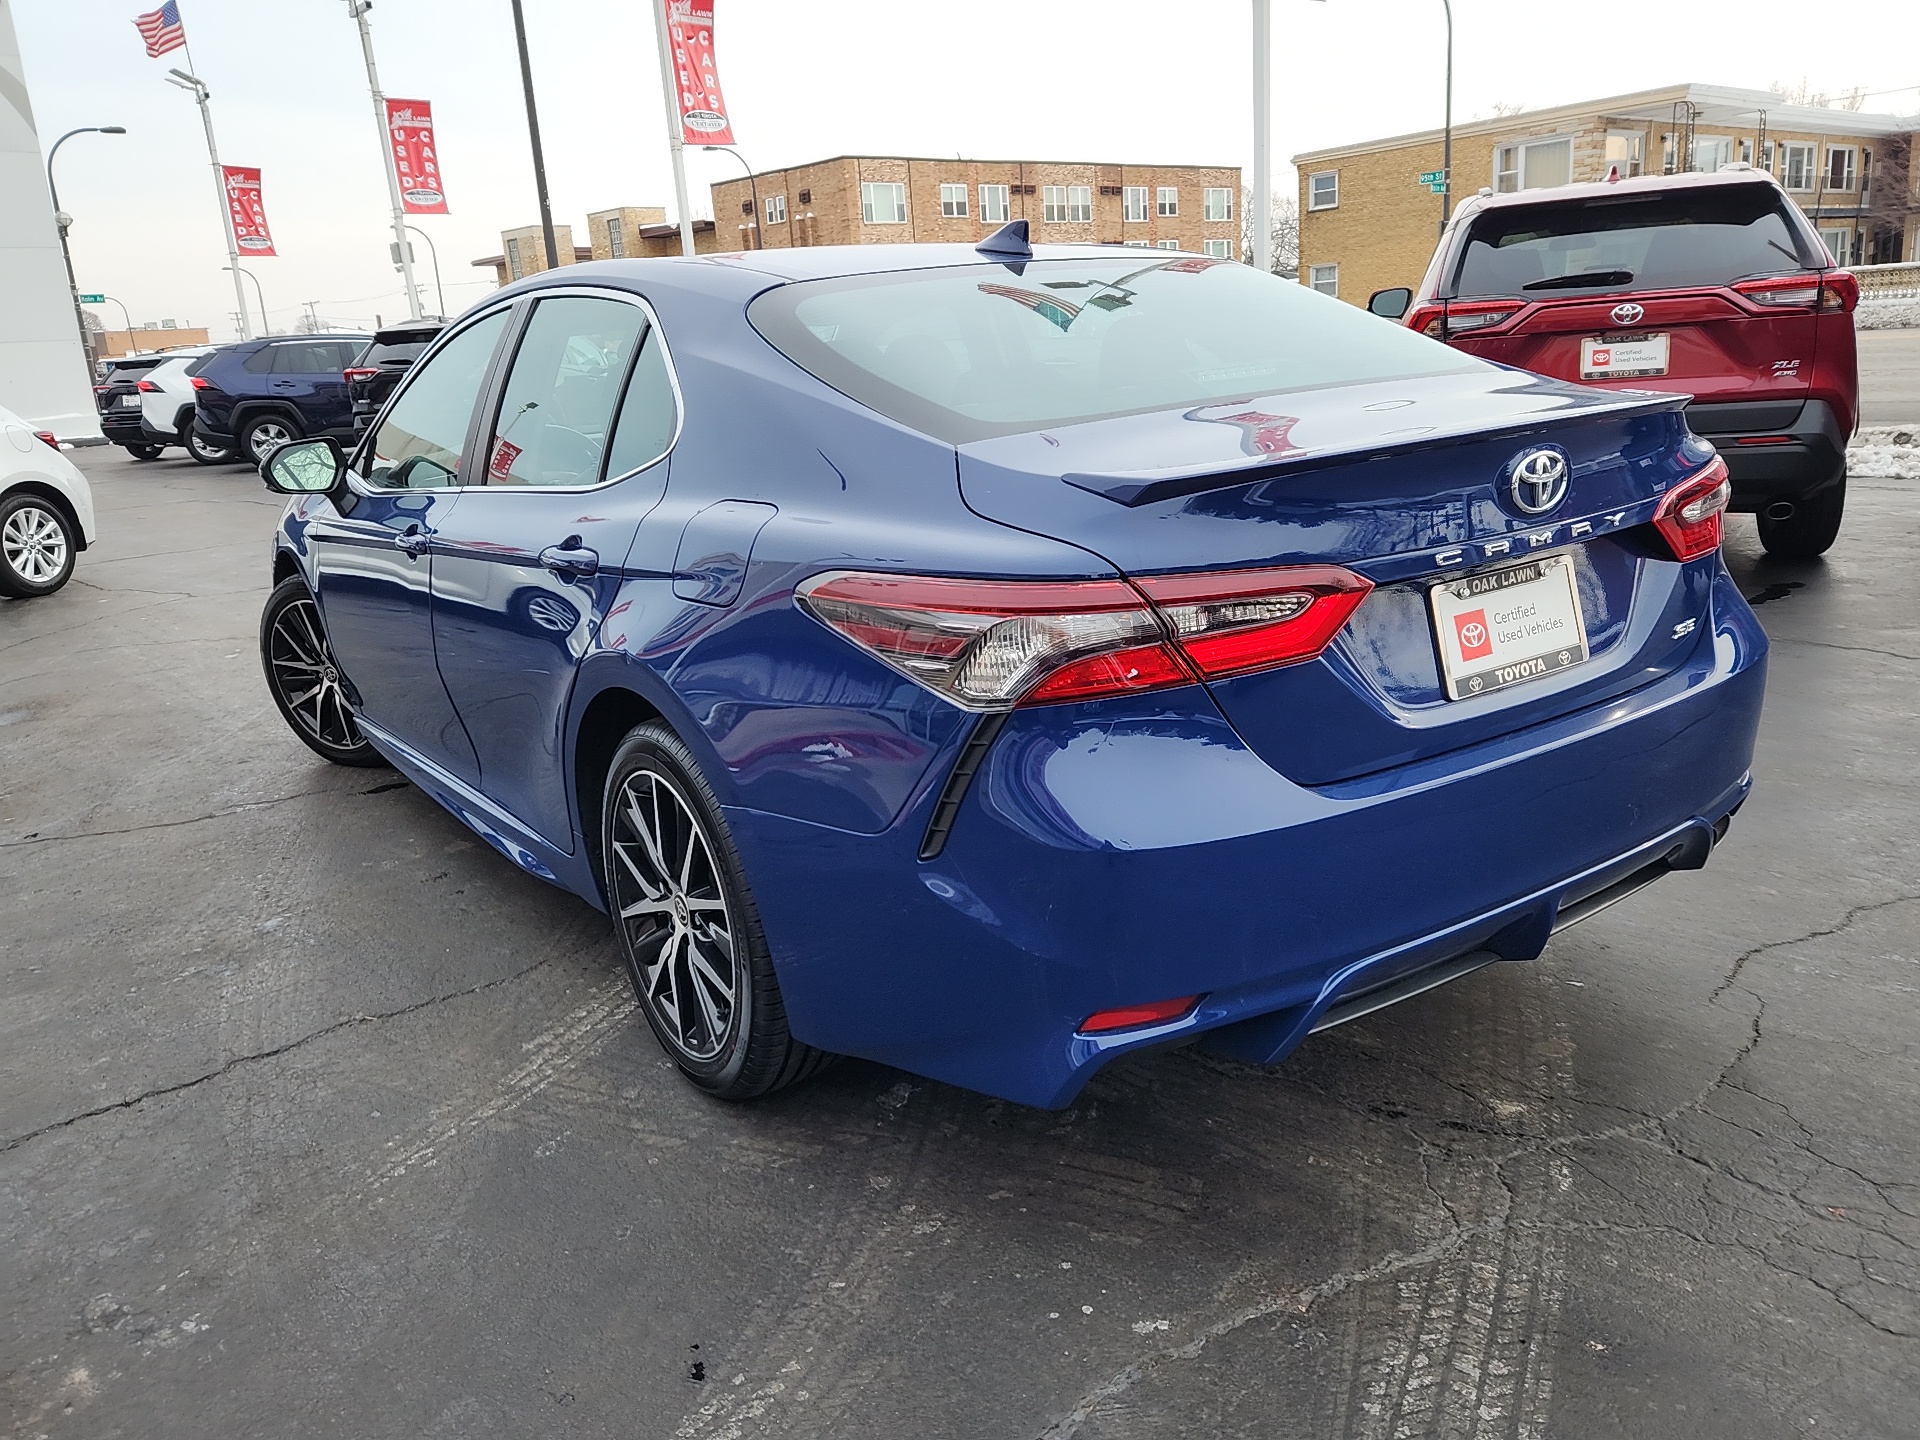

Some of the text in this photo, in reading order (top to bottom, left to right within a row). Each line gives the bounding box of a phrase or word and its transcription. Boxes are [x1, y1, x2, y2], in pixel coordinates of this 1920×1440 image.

[692, 9, 712, 18] LAWN
[672, 26, 695, 107] USED
[698, 30, 719, 108] CARS
[394, 129, 415, 188] USED
[420, 130, 439, 189] CARS
[230, 190, 247, 235] USED
[250, 191, 266, 235] CARS
[1608, 369, 1640, 377] TOYOTA
[1632, 355, 1657, 363] Vehicles
[1435, 512, 1626, 566] CAMRY
[1472, 567, 1536, 593] OAK LAWN
[1493, 603, 1537, 625] Certified
[1671, 617, 1697, 639] SE
[1497, 616, 1564, 644] Used Vehicles
[1495, 658, 1547, 684] TOYOTA
